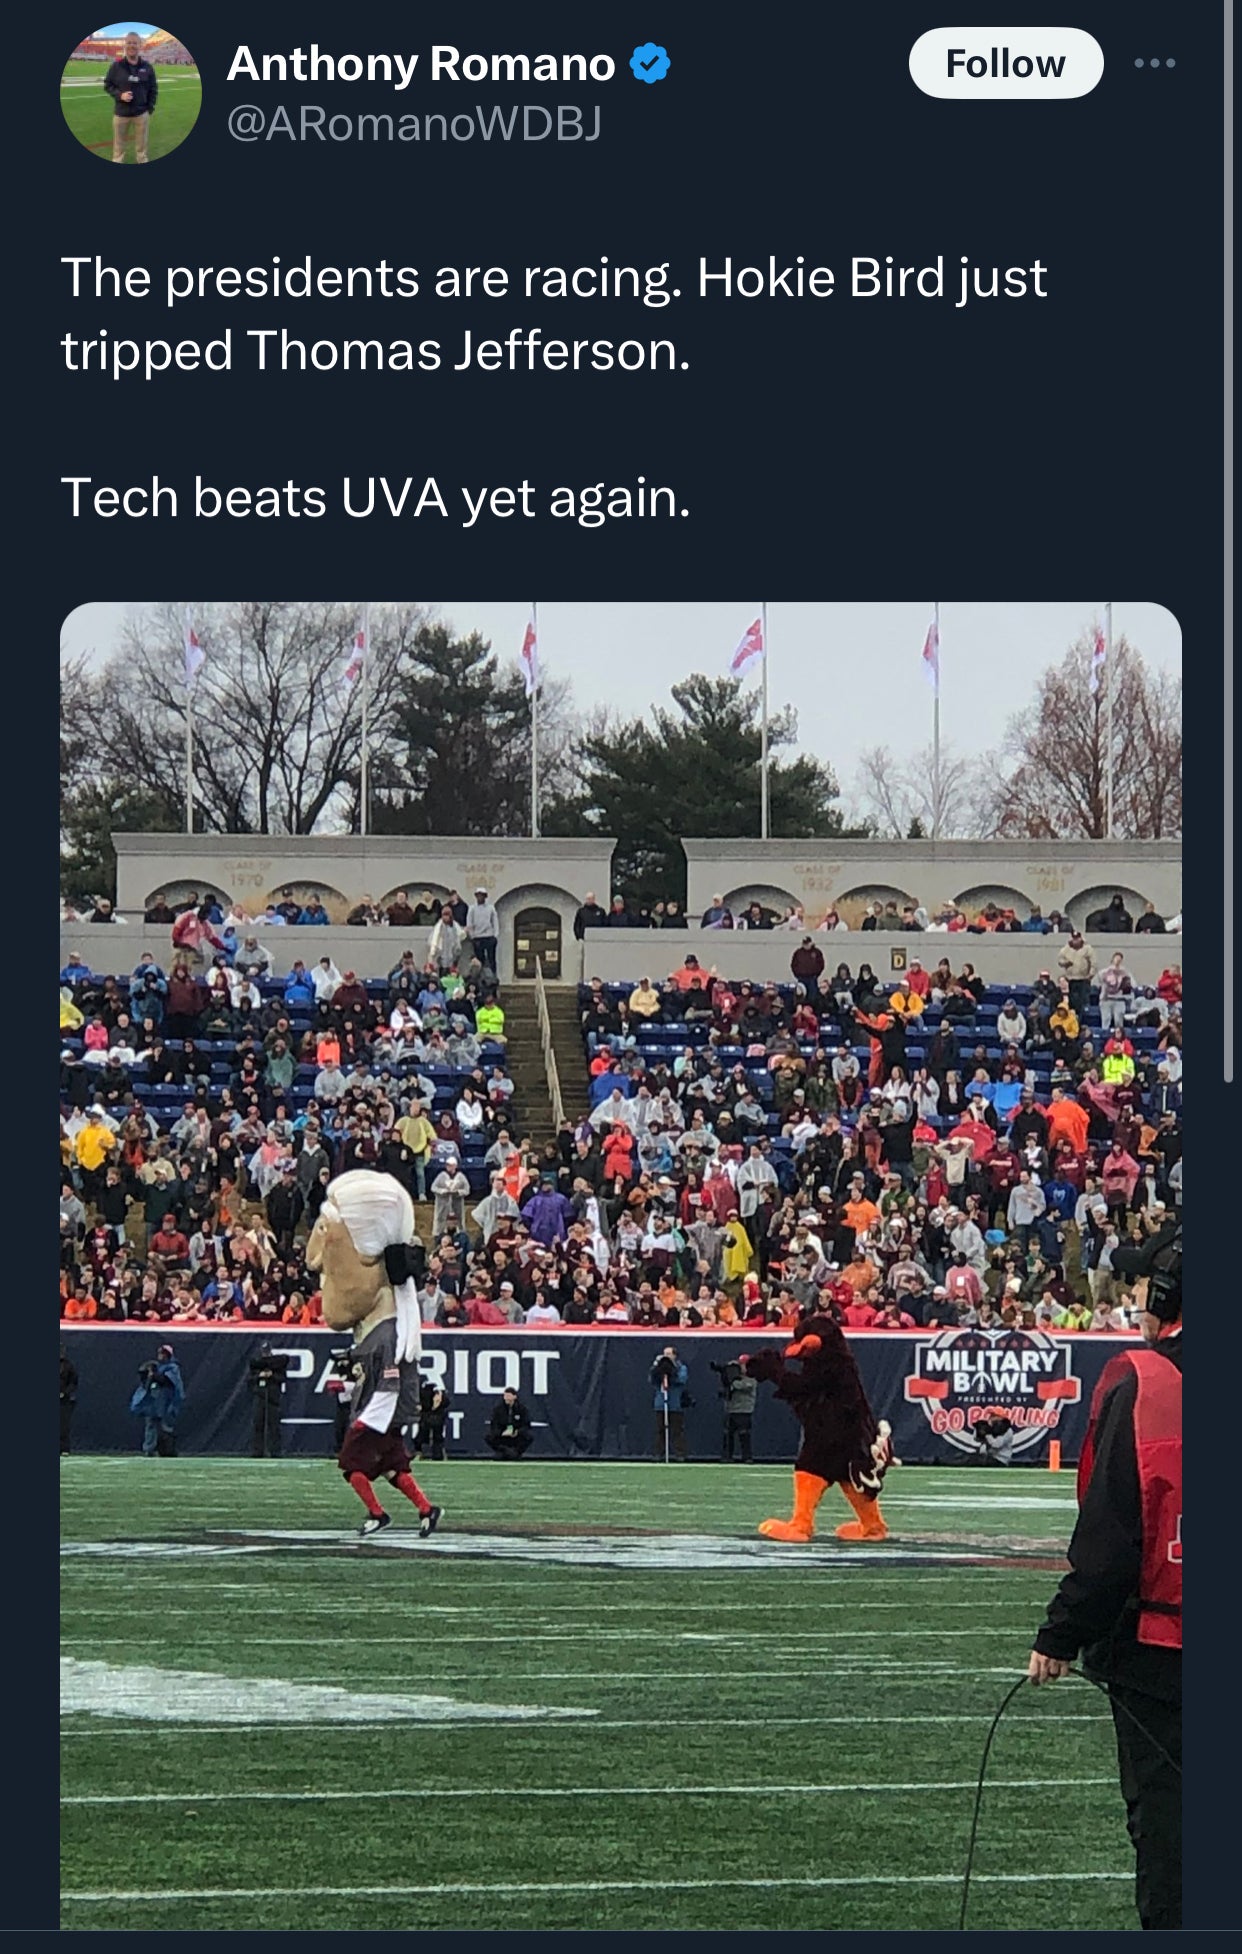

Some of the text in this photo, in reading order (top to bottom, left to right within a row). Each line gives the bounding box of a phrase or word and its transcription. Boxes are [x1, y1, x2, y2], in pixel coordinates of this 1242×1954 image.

[893, 954, 904, 968] D
[270, 1348, 561, 1395] PARIOT
[926, 1350, 1058, 1371] MILITARY
[954, 1371, 1034, 1393] BOWL
[932, 1408, 965, 1433] GO
